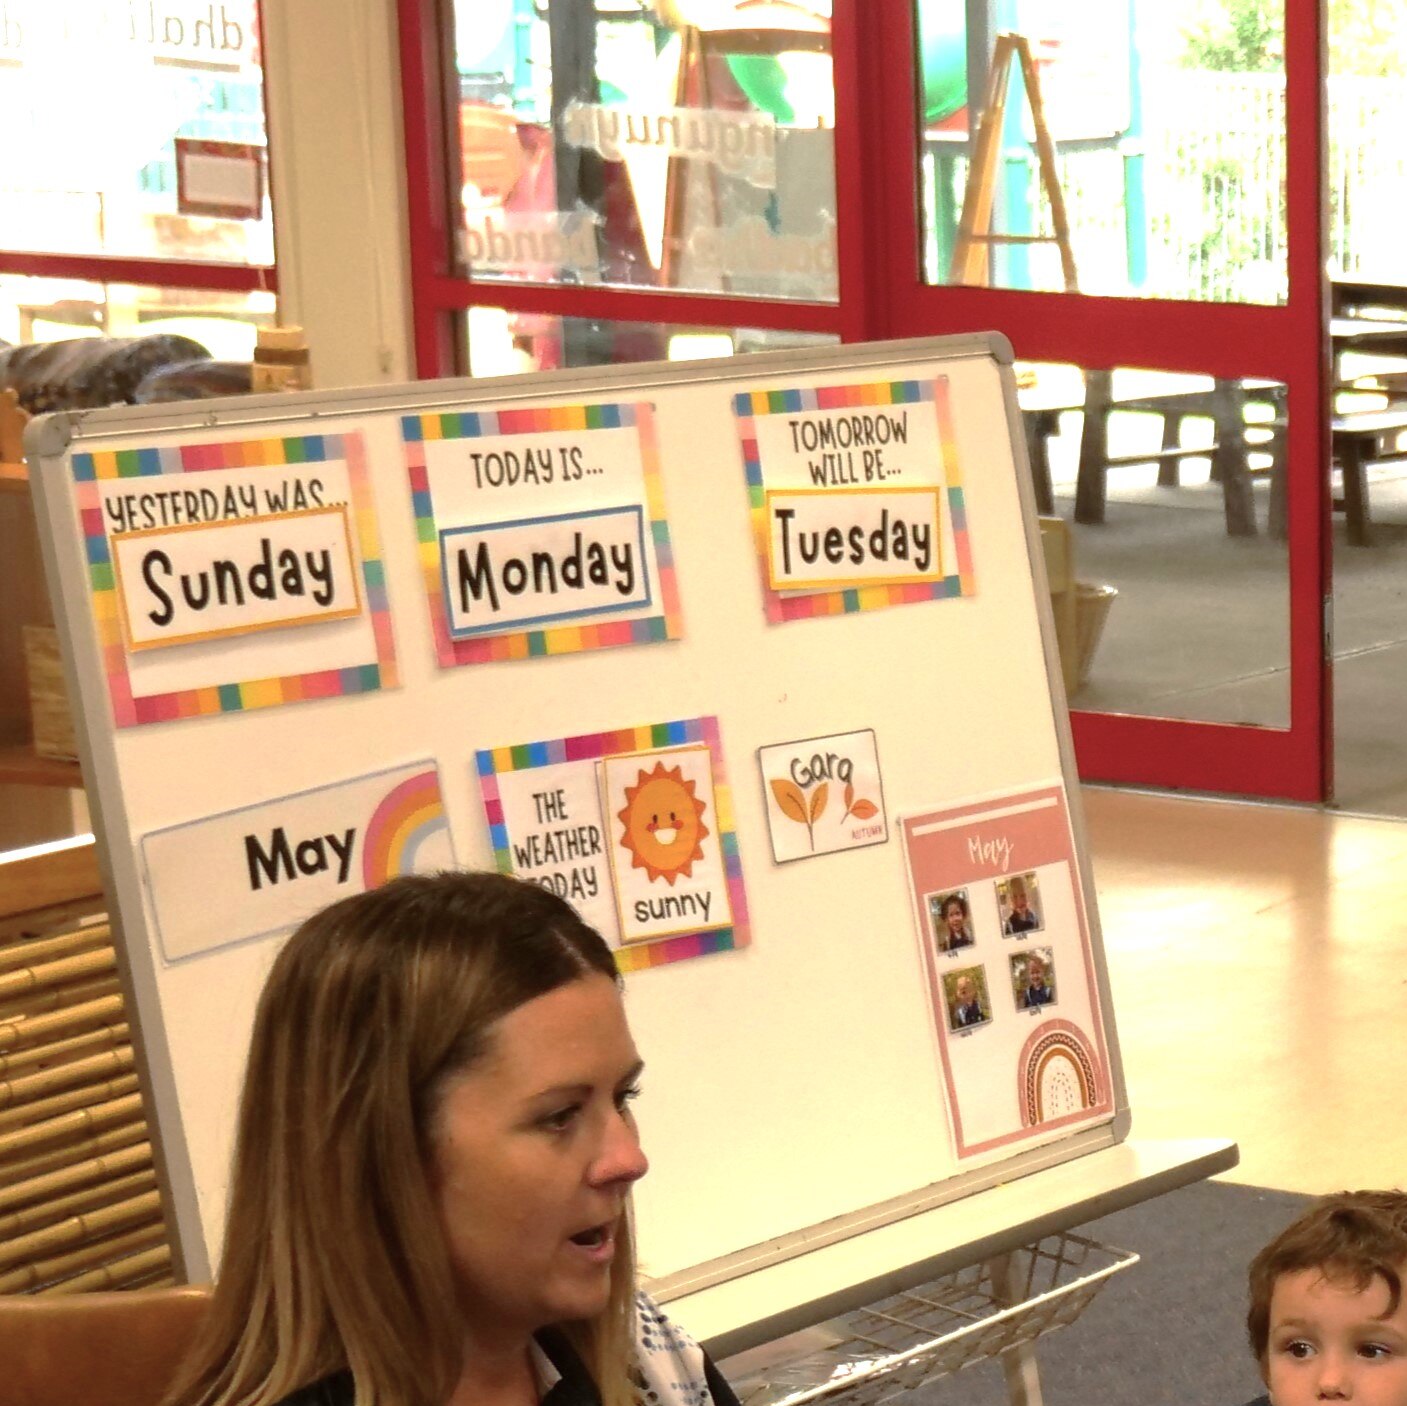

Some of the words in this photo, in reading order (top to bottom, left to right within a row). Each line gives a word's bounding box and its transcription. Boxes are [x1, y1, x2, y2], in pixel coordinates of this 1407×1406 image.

[789, 411, 908, 453] TOMORROW
[470, 449, 554, 488] TODAY
[559, 446, 603, 482] IS...
[808, 451, 859, 487] WILL
[863, 449, 901, 482] BE...
[105, 484, 257, 533] YESTERDAY
[775, 508, 931, 575] Tuesday
[142, 538, 334, 626] Sunday
[457, 532, 635, 613] Monday
[790, 752, 854, 790] Gara
[532, 789, 568, 824] THE
[244, 827, 357, 891] May
[513, 825, 602, 869] WEATHER
[967, 834, 1015, 873] May
[528, 866, 599, 899] ODAY
[634, 891, 711, 923] sunny
